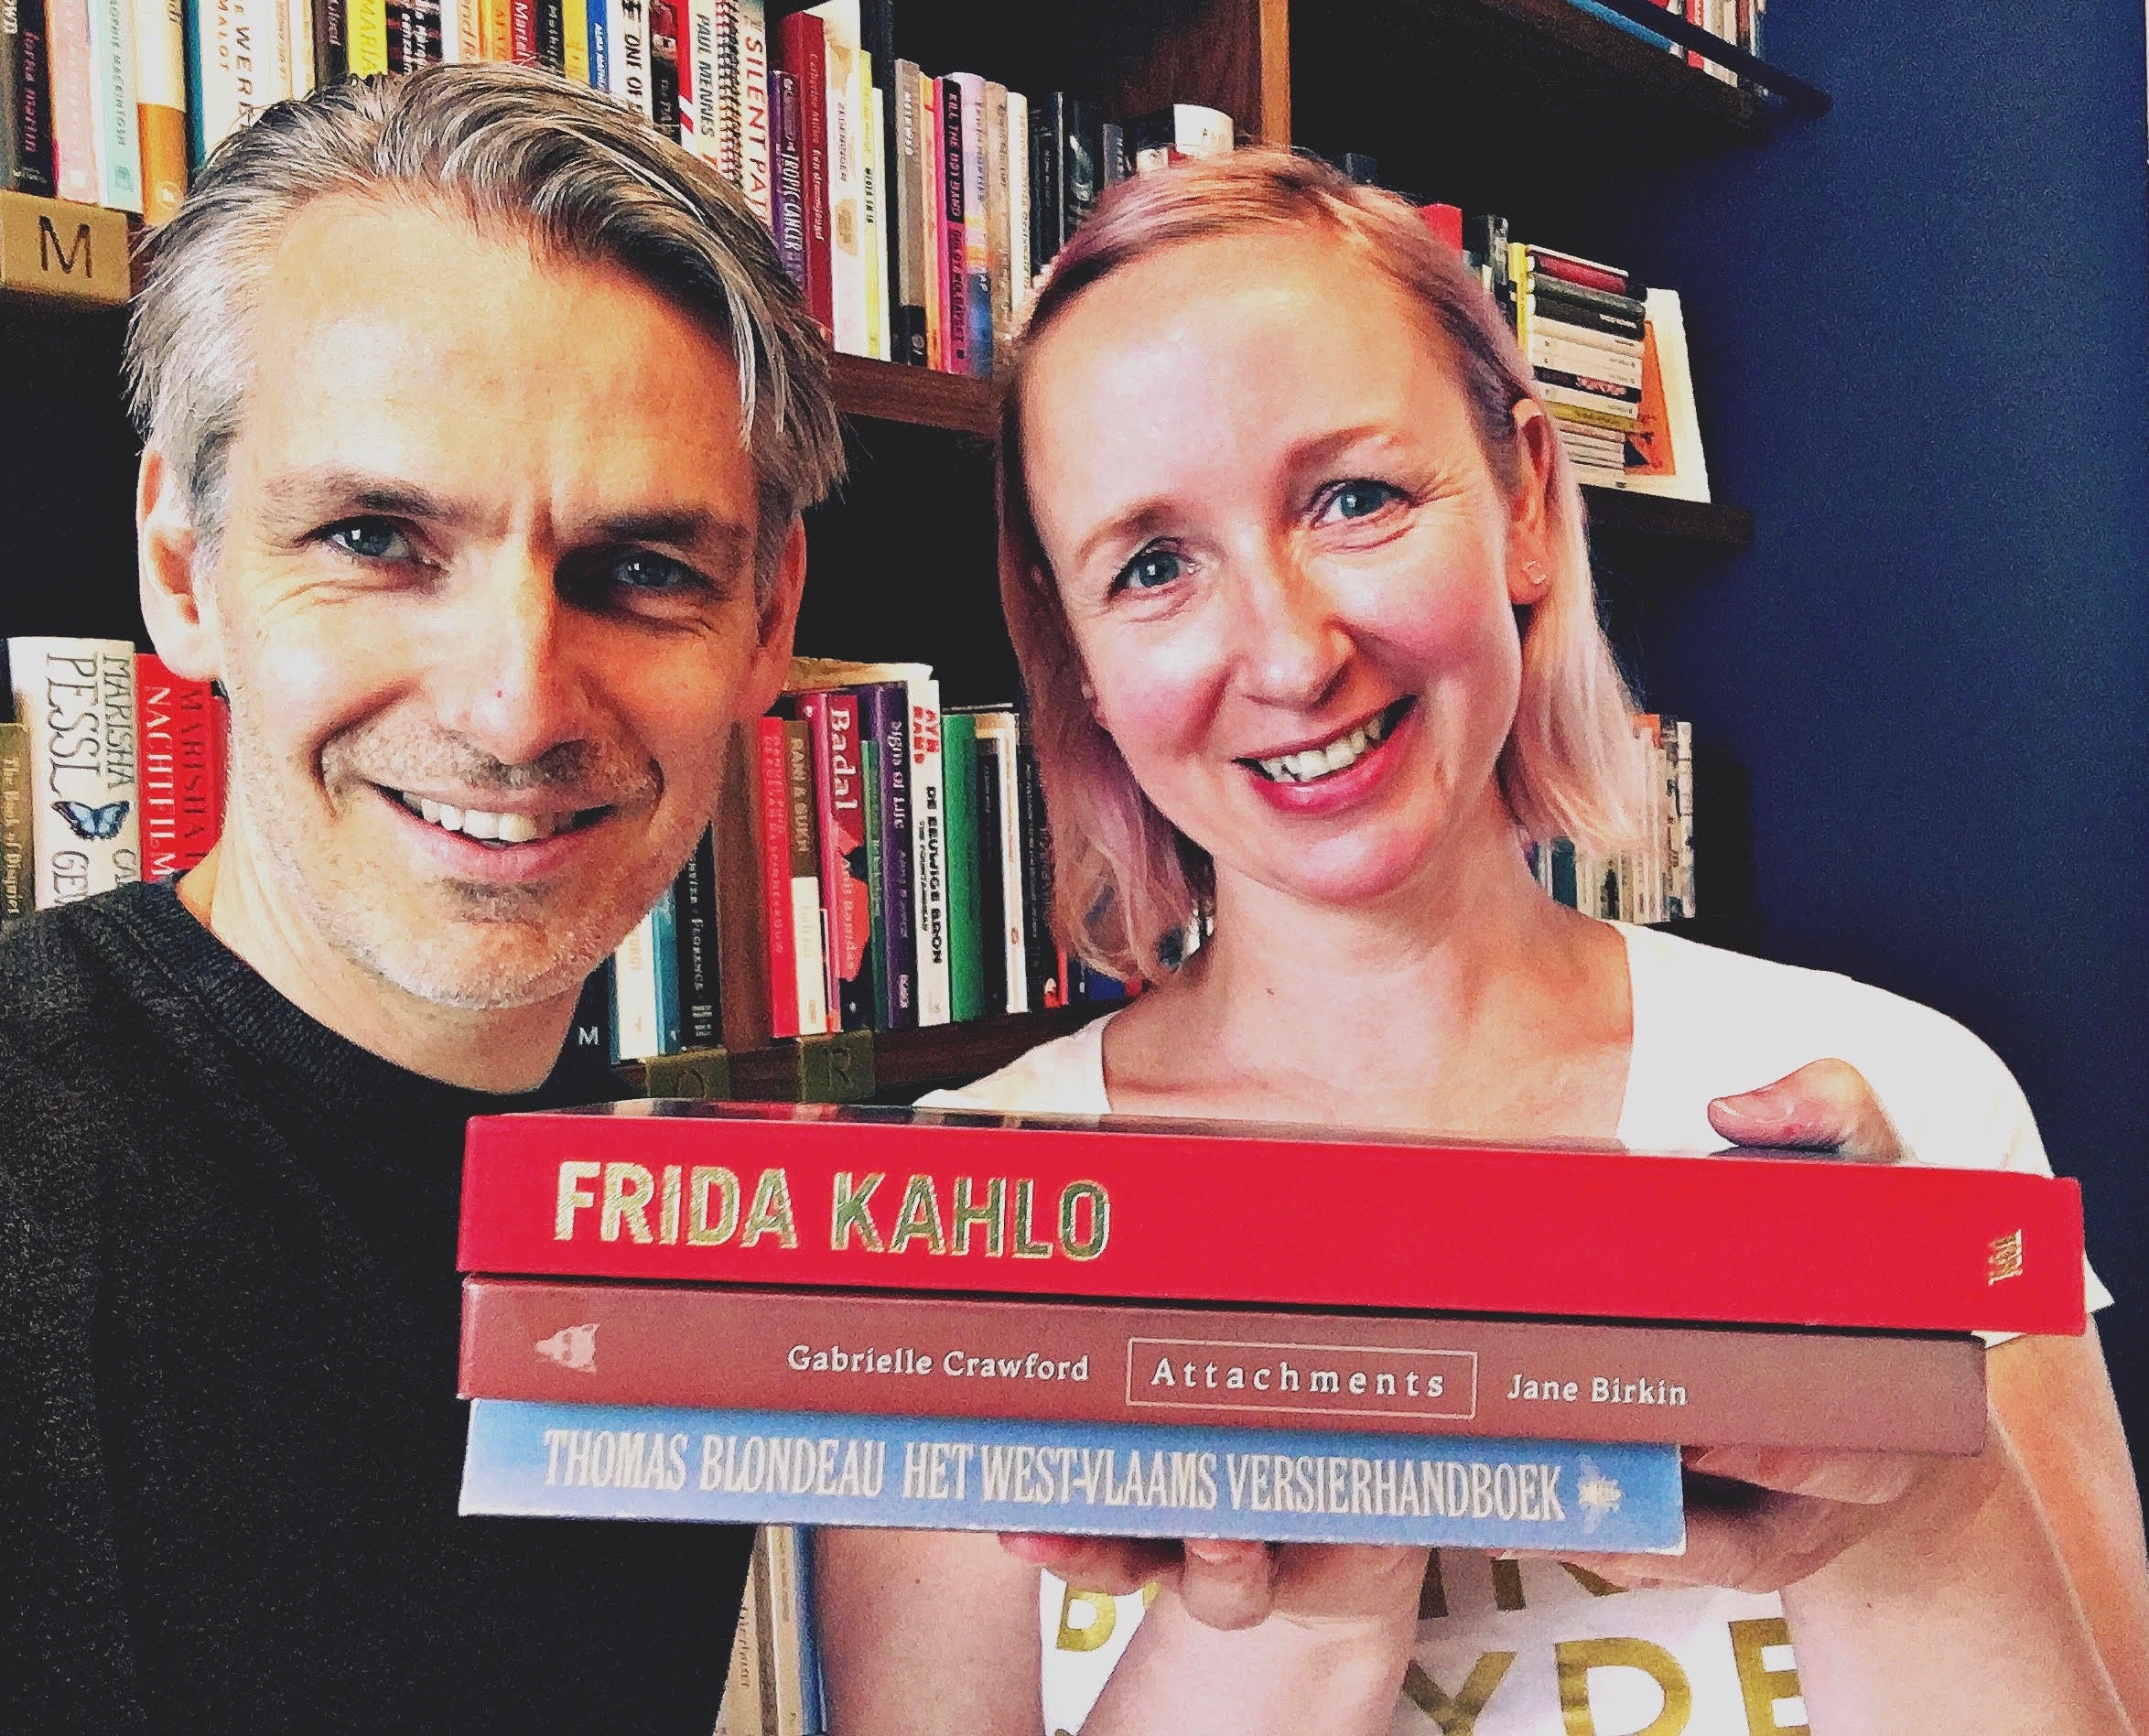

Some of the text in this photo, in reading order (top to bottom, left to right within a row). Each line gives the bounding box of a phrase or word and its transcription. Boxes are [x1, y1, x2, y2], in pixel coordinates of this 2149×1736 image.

[697, 15, 711, 55] PAUL
[698, 60, 715, 137] MENNES
[744, 37, 766, 152] SILENT
[782, 154, 800, 198] TROPIC
[38, 215, 92, 278] M
[783, 203, 803, 251] CANCER
[46, 651, 102, 799] PESSL
[103, 653, 135, 790] MARISHA
[913, 706, 925, 766] RAND
[925, 709, 941, 753] AYN
[4, 757, 20, 785] The
[146, 686, 177, 879] NACHTFILM
[179, 689, 207, 838] MARISHA
[831, 707, 859, 811] Badal
[887, 720, 906, 830] Signs of Life
[925, 785, 943, 965] DE EEUWIGE BRON
[578, 1026, 599, 1046] M
[554, 1159, 1111, 1262] FRIDA KAHLO
[786, 1344, 1090, 1383] Gabrielle Crawford
[1150, 1356, 1447, 1400] Attachments
[1506, 1371, 1689, 1407] Jane Birkin
[544, 1428, 1566, 1523] THOMAS BLONDEAU HET WEST-VLAAMS VERSIERHANDBOEK
